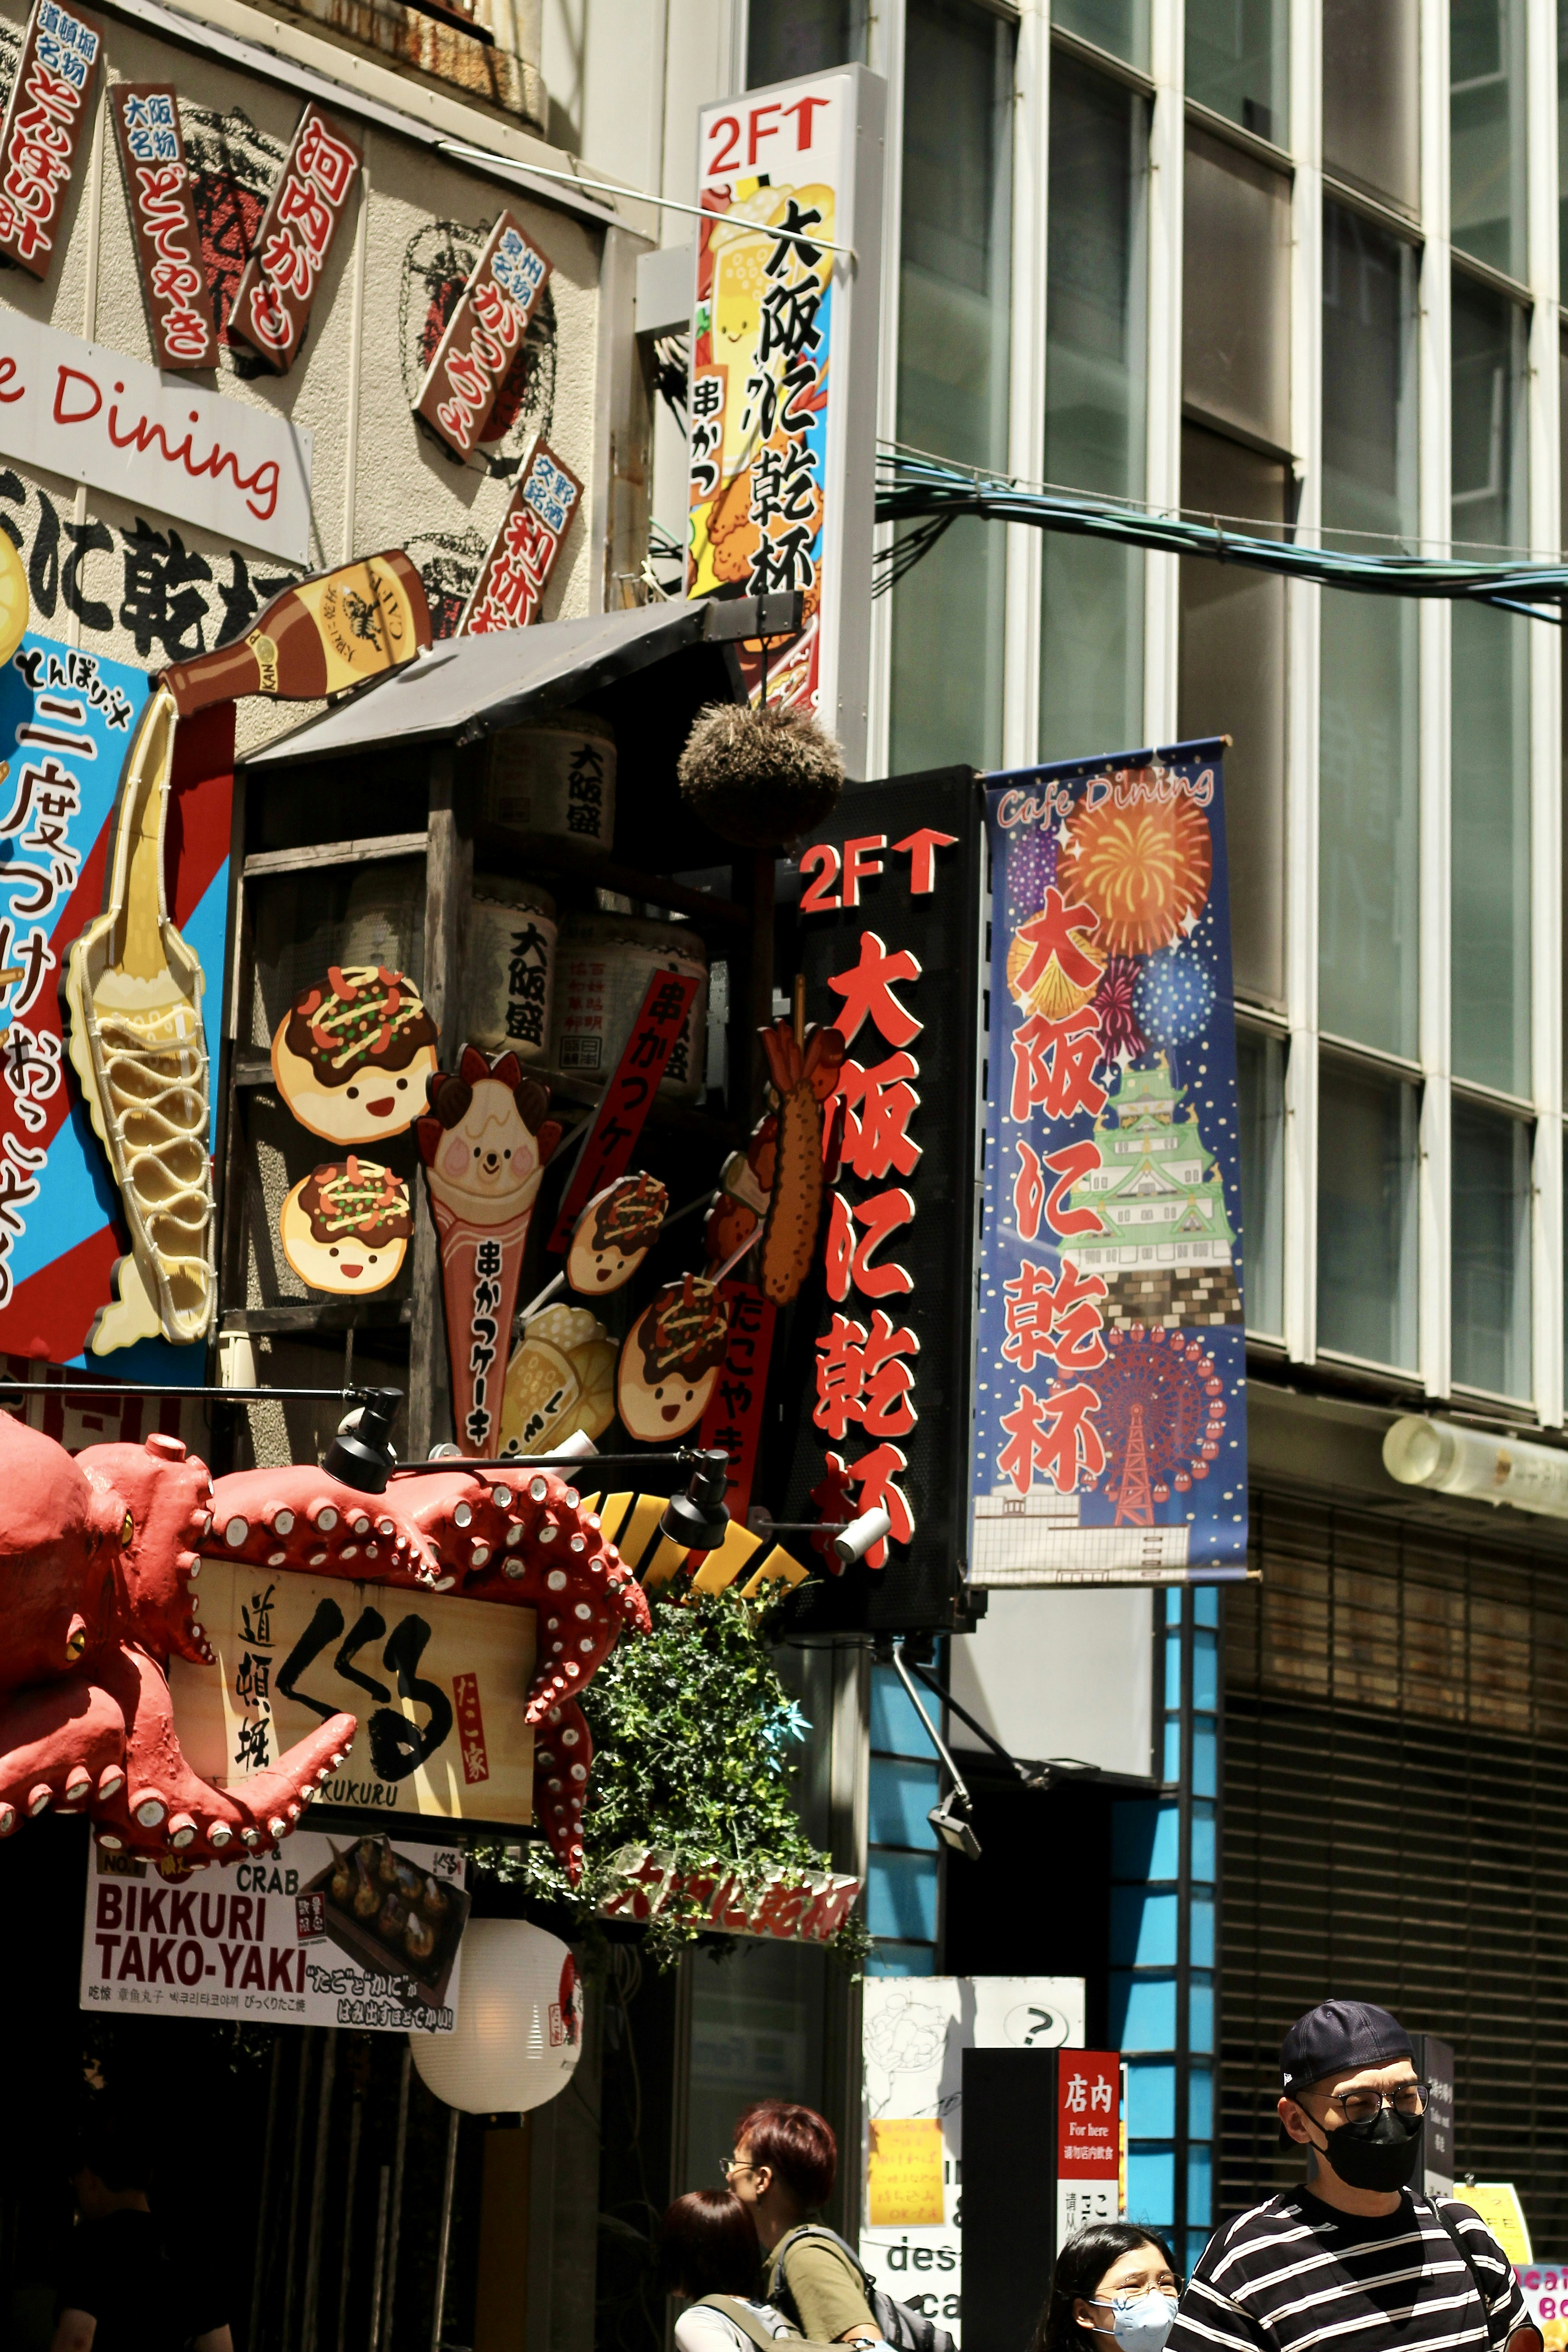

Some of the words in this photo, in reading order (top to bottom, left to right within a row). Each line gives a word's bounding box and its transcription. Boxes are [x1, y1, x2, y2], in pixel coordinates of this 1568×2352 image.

[36, 34, 88, 88] 名物
[124, 94, 173, 127] 大阪
[130, 127, 178, 161] 名物
[707, 103, 781, 176] 2F
[137, 162, 210, 359] どてやき
[492, 251, 535, 307] 名物
[743, 200, 823, 593] 大阪に乾杯
[52, 364, 279, 520] Dining
[691, 378, 720, 495] 串かつ
[567, 743, 603, 839] 大阪盛
[998, 781, 1073, 830] Cafe
[1087, 768, 1214, 810] Dining
[799, 835, 887, 912] 2F
[504, 921, 548, 1047] 大阪盛
[997, 886, 1108, 1494] 大阪に乾杯
[811, 931, 923, 1575] 大阪に乾杯
[466, 1240, 503, 1444] 串かつケーキ
[713, 1291, 763, 1487] たこやき
[235, 1585, 275, 1772] 道頓堀
[275, 1597, 452, 1782] くくる
[320, 1779, 397, 1807] KUKURU
[96, 1883, 266, 1942] BIKKURI
[236, 1864, 299, 1896] CRAB
[95, 1933, 307, 1994] TAKO-YAKI
[1064, 2073, 1113, 2113] 店内
[1069, 2122, 1085, 2136] For
[1088, 2123, 1109, 2137] here
